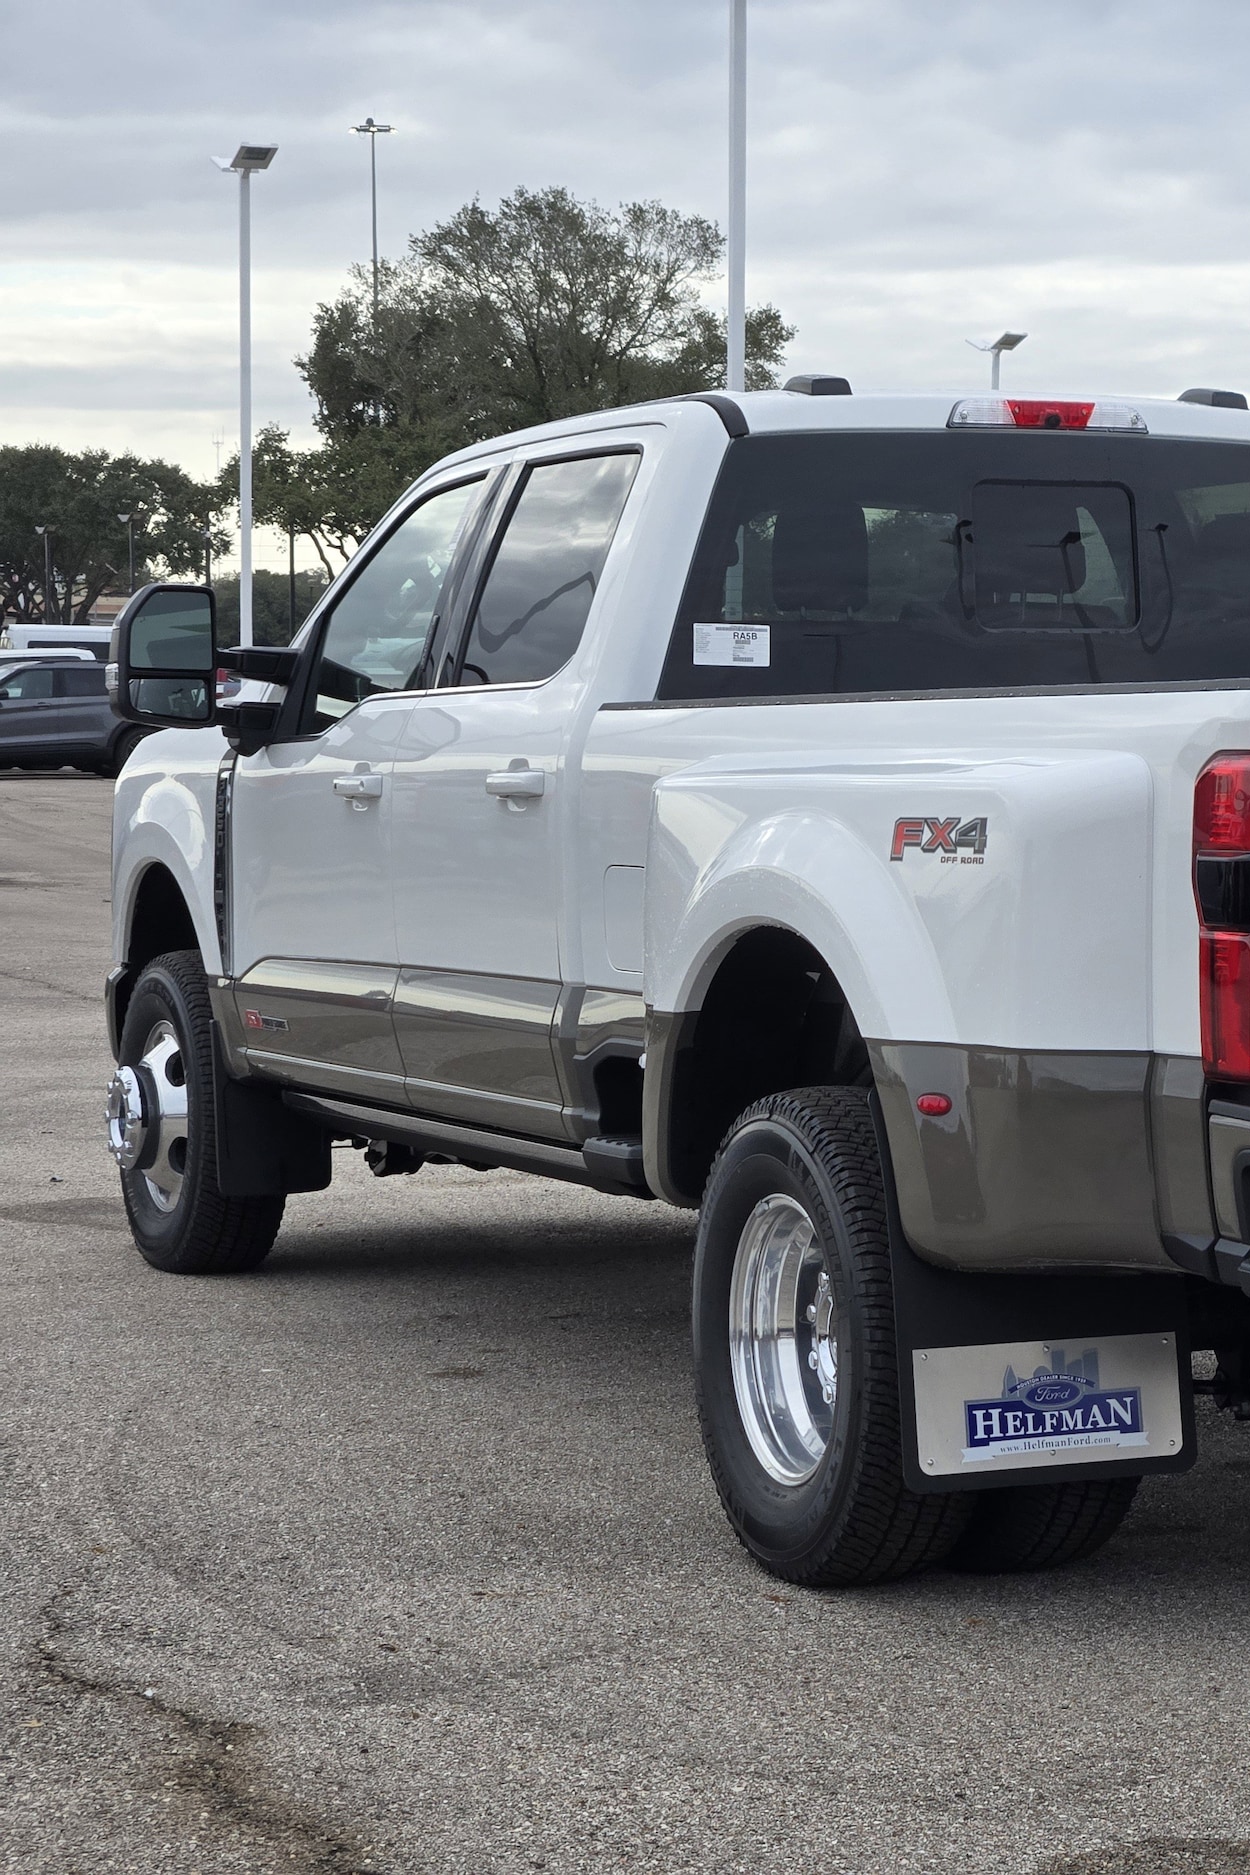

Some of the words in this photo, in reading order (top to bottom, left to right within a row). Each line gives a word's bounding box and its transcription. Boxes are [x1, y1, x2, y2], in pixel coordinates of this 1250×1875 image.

[732, 632, 758, 641] RA5B
[889, 817, 988, 862] FX4
[940, 856, 958, 864] OFF
[960, 856, 984, 865] ROAD
[1034, 1385, 1071, 1402] Ford
[972, 1397, 1134, 1440] HELFMAN
[1000, 1436, 1112, 1453] www.HelfmanFord.com
